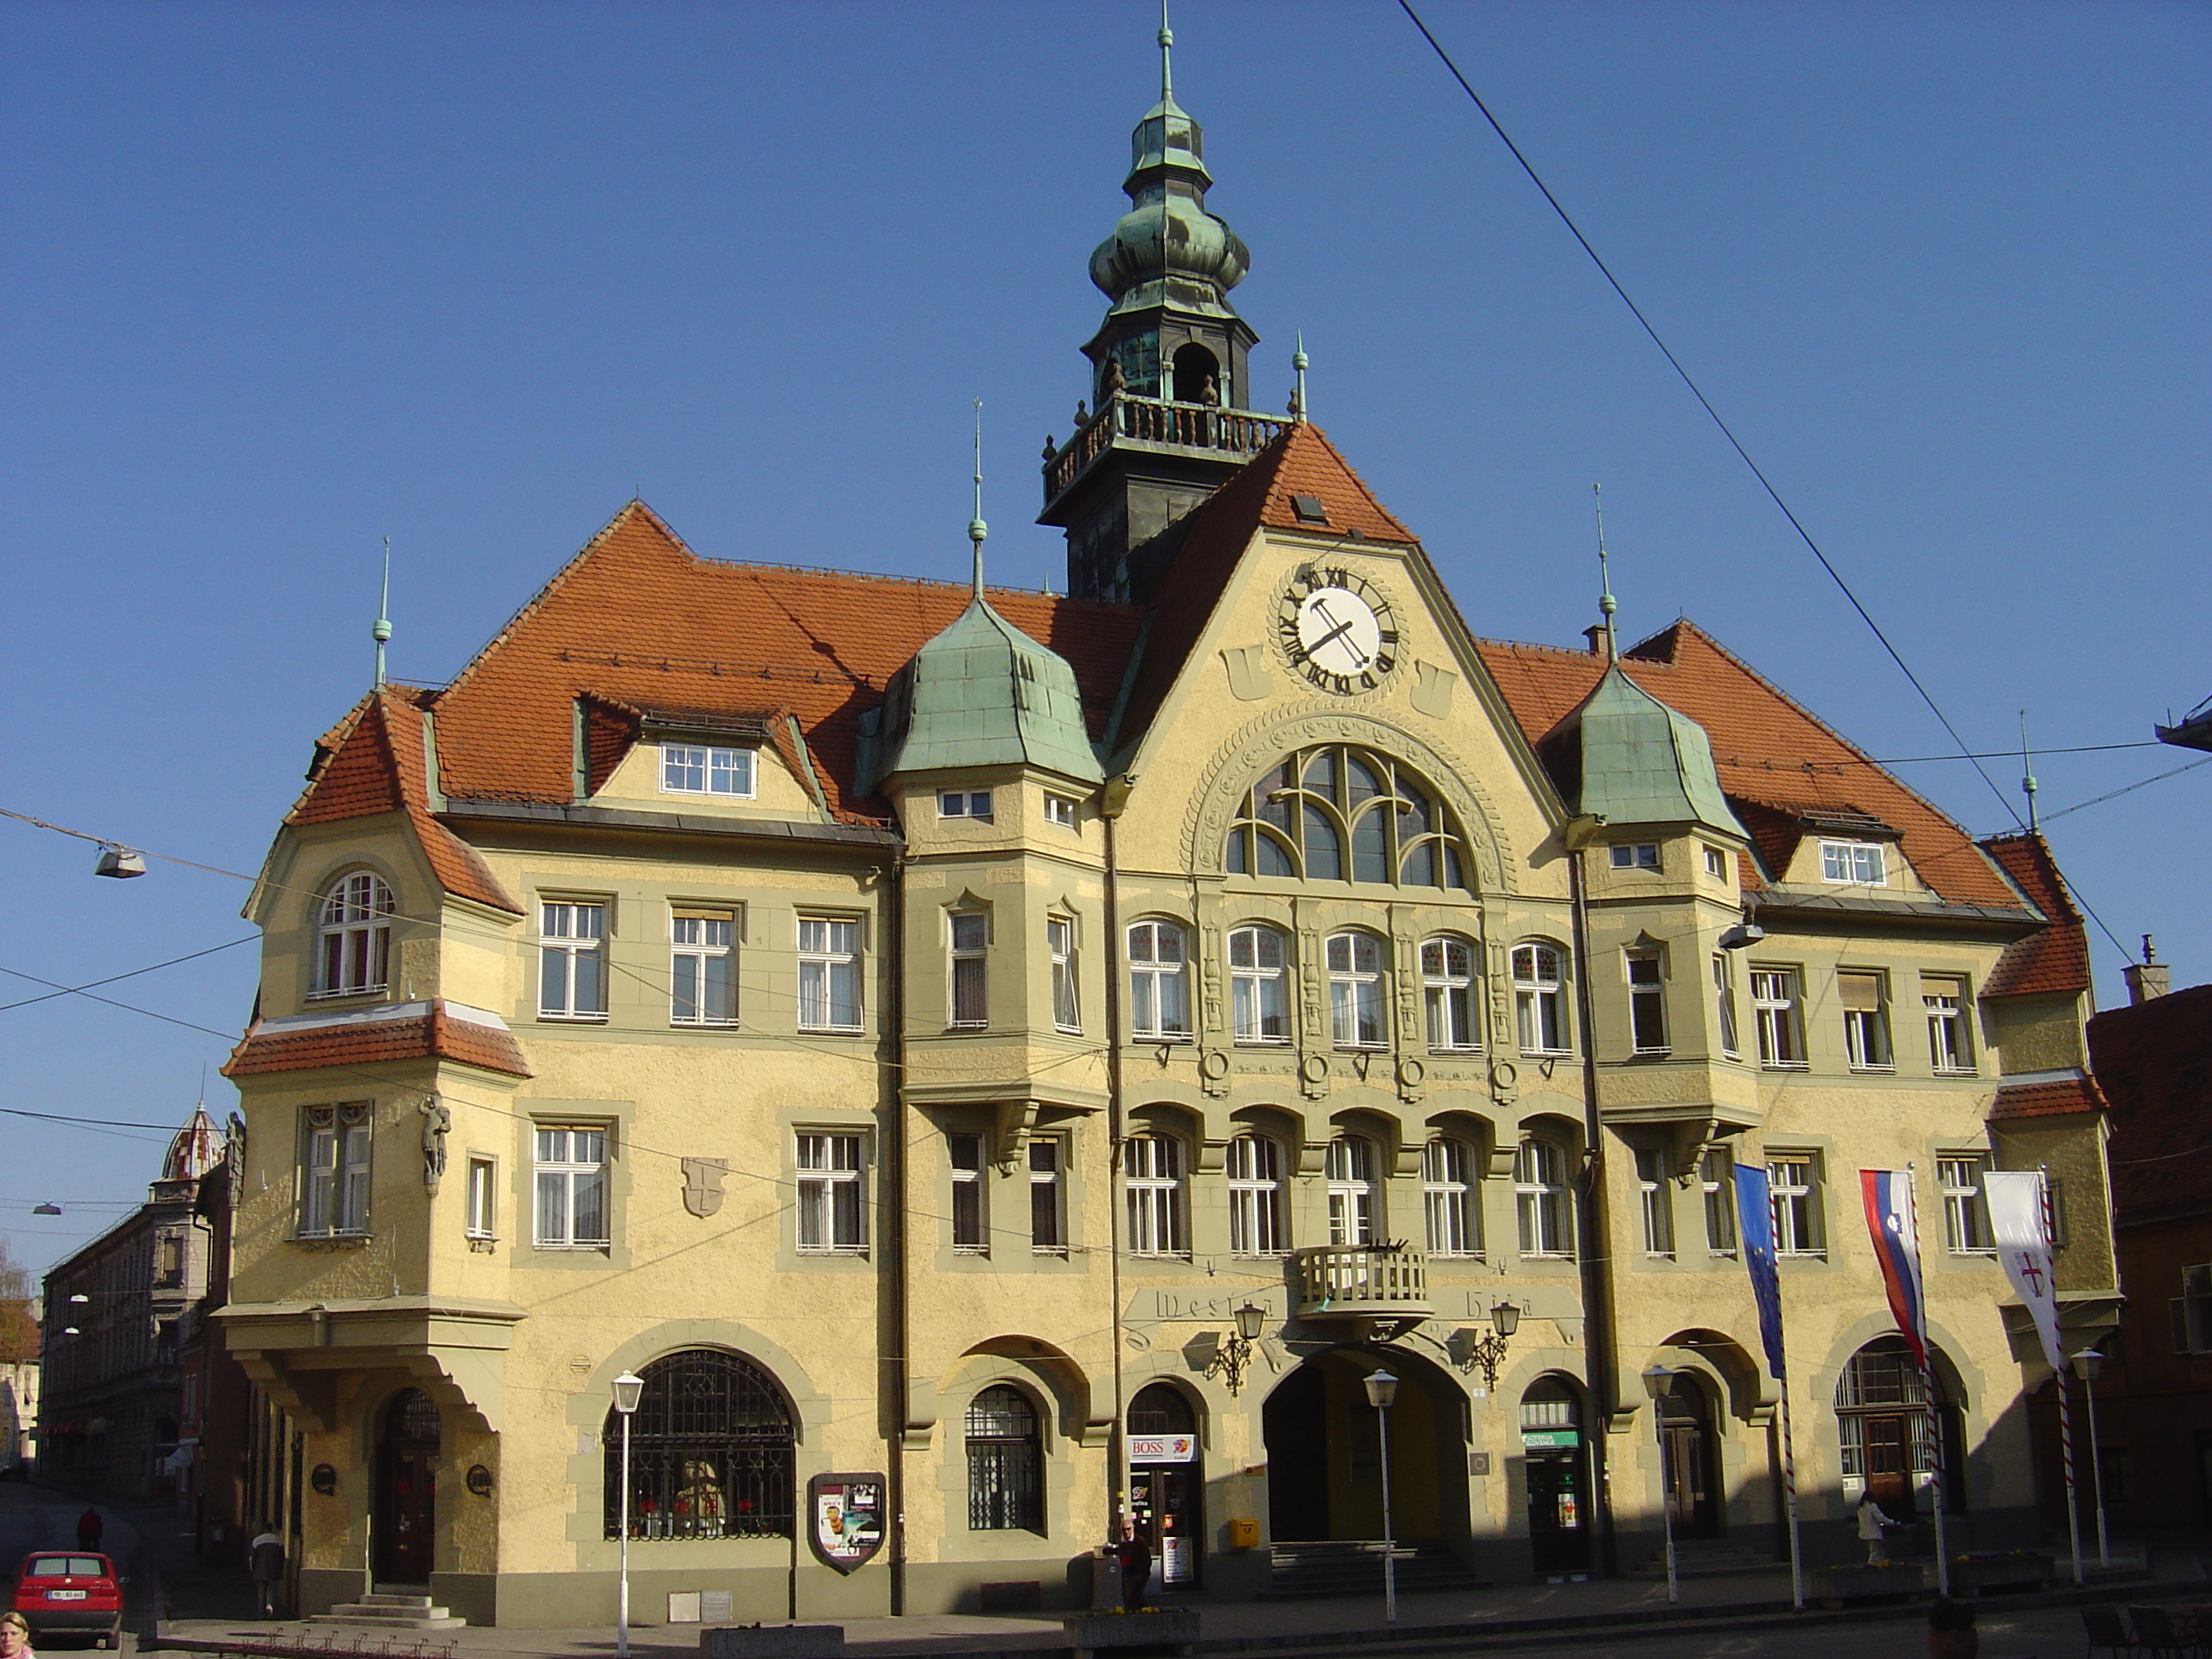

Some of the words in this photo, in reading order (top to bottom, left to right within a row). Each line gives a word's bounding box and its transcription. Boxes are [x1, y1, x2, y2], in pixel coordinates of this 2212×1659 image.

[1326, 567, 1348, 588] XII
[1358, 579, 1367, 595] I
[1284, 588, 1306, 608] X
[1373, 602, 1391, 617] II
[1279, 614, 1300, 637] IX
[1381, 630, 1400, 643] III
[1335, 673, 1353, 696] VI
[1360, 670, 1378, 690] V
[1155, 1289, 1274, 1318] Mesta
[1132, 1441, 1163, 1453] BOSS
